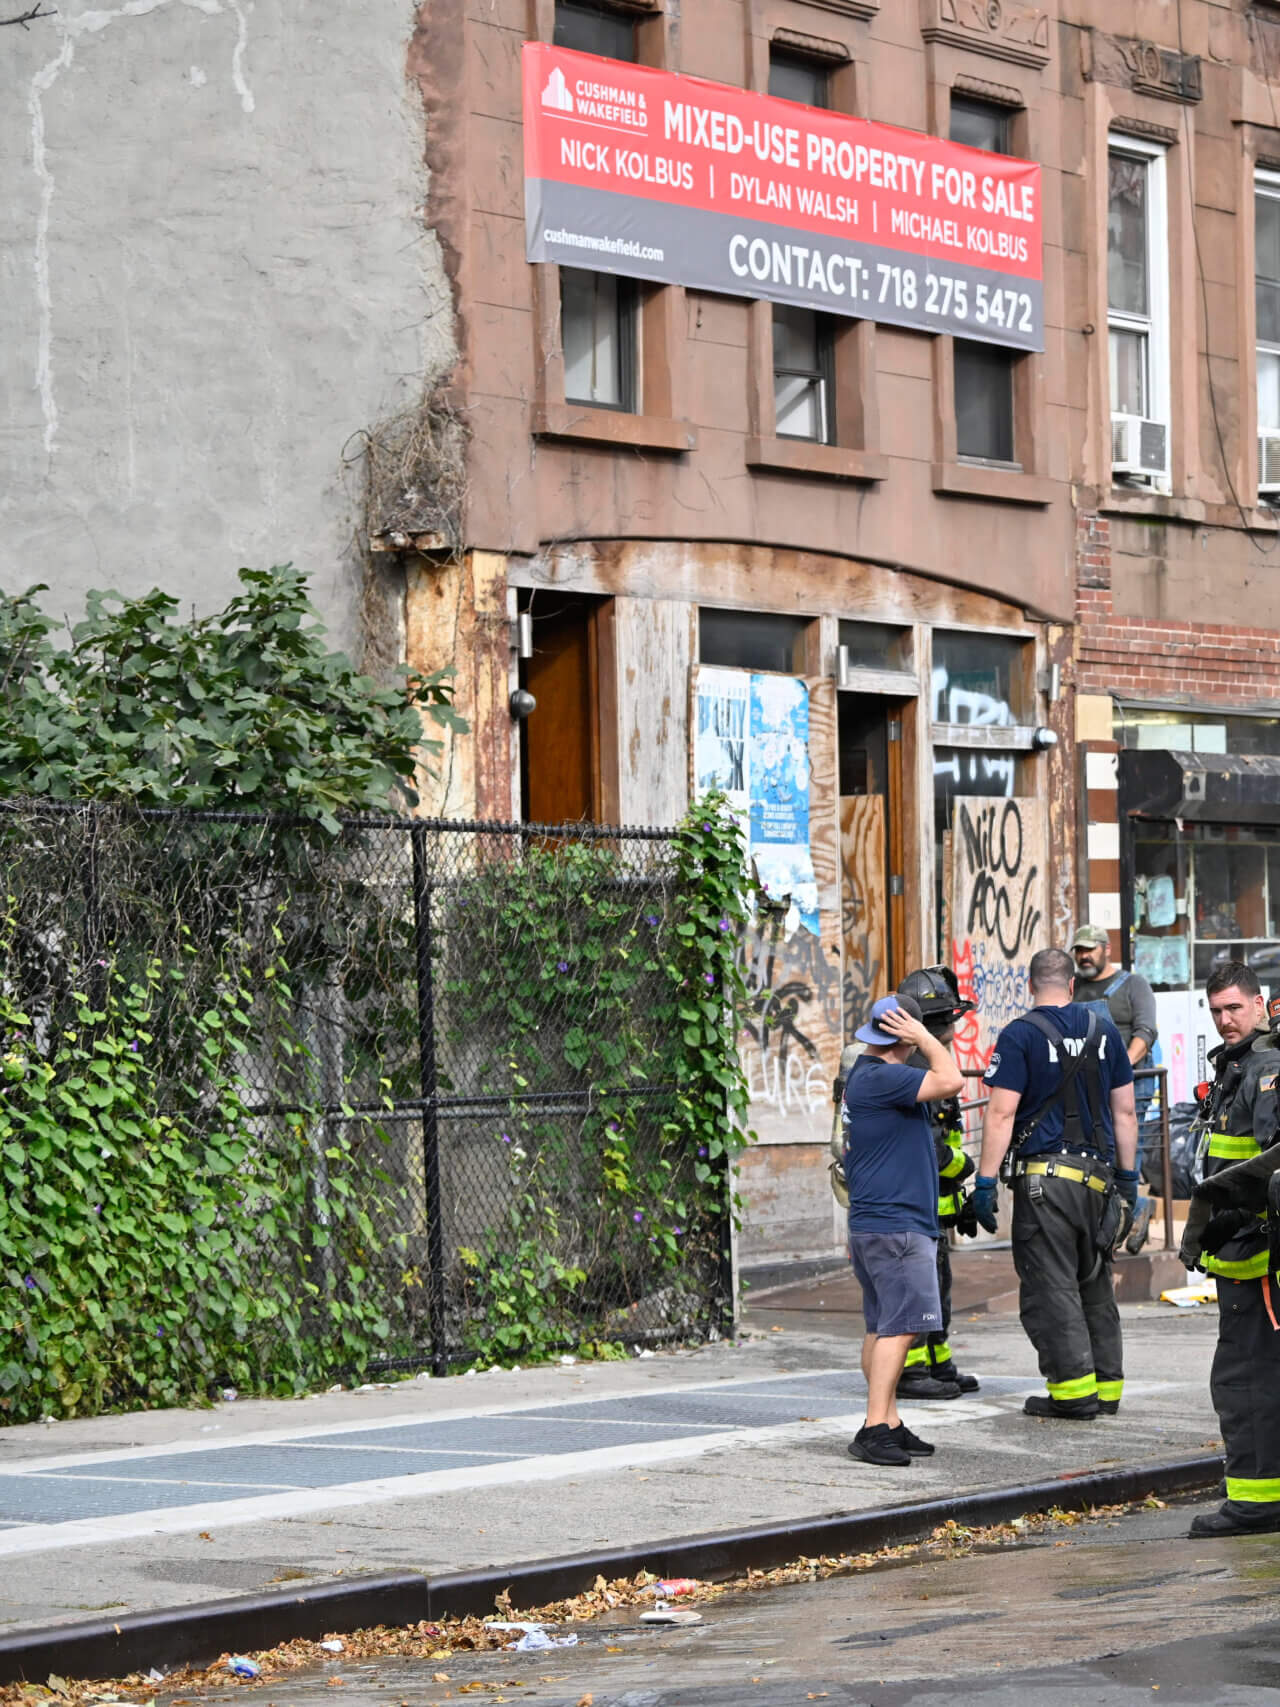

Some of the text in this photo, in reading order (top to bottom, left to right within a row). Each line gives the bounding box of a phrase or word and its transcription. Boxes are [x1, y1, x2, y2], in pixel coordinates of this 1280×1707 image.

[575, 80, 647, 109] CUSHMAN &
[575, 98, 648, 127] WAKEFIELD
[663, 100, 1035, 222] MIXED-USE PROPERTY FOR SALE
[560, 137, 1029, 262] NICK KOLBUS DYLAN WALSH MICHAEL KOLBUS
[543, 228, 664, 262] cushmanwakefield.com
[729, 234, 1033, 332] CONTACT: 718 275 5472
